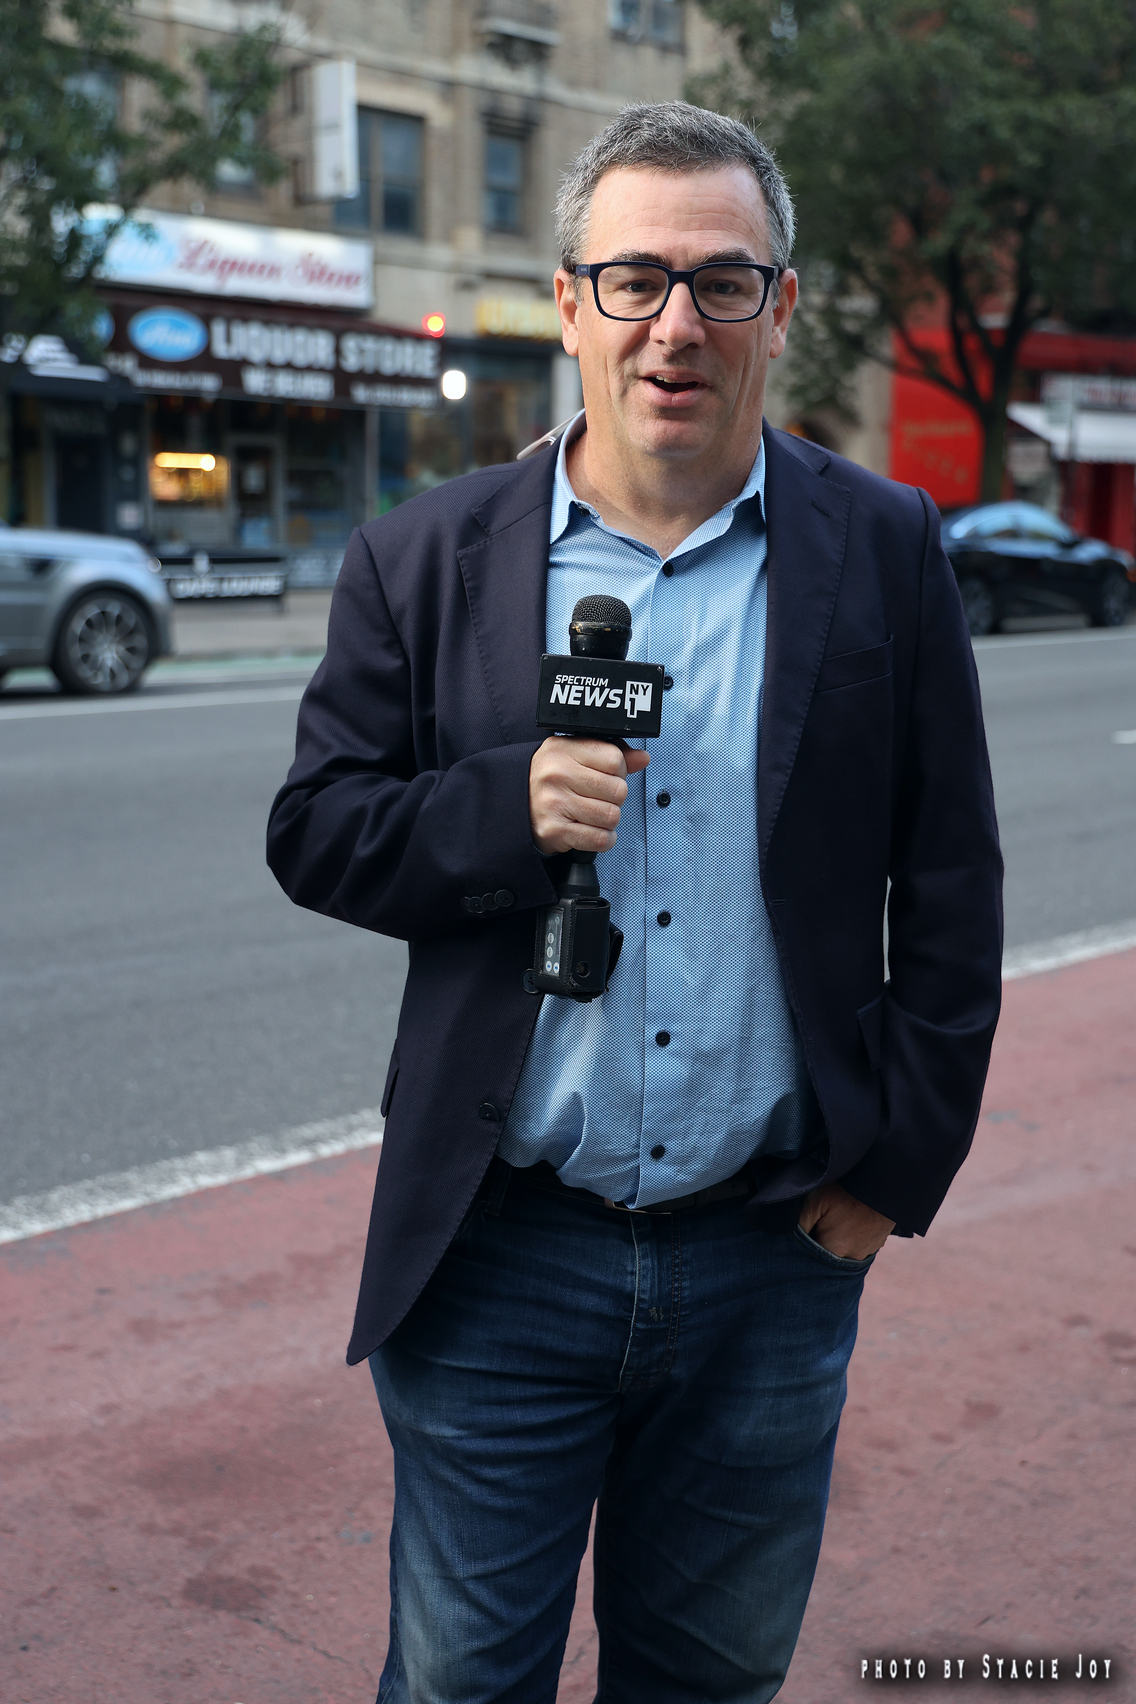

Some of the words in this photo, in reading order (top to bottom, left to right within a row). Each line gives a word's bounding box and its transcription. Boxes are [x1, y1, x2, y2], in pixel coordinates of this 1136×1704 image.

[209, 316, 337, 370] LIQUOR
[338, 331, 441, 379] STORE
[554, 674, 609, 687] SPECTRUM
[629, 683, 650, 696] NY
[549, 684, 624, 709] NEWS
